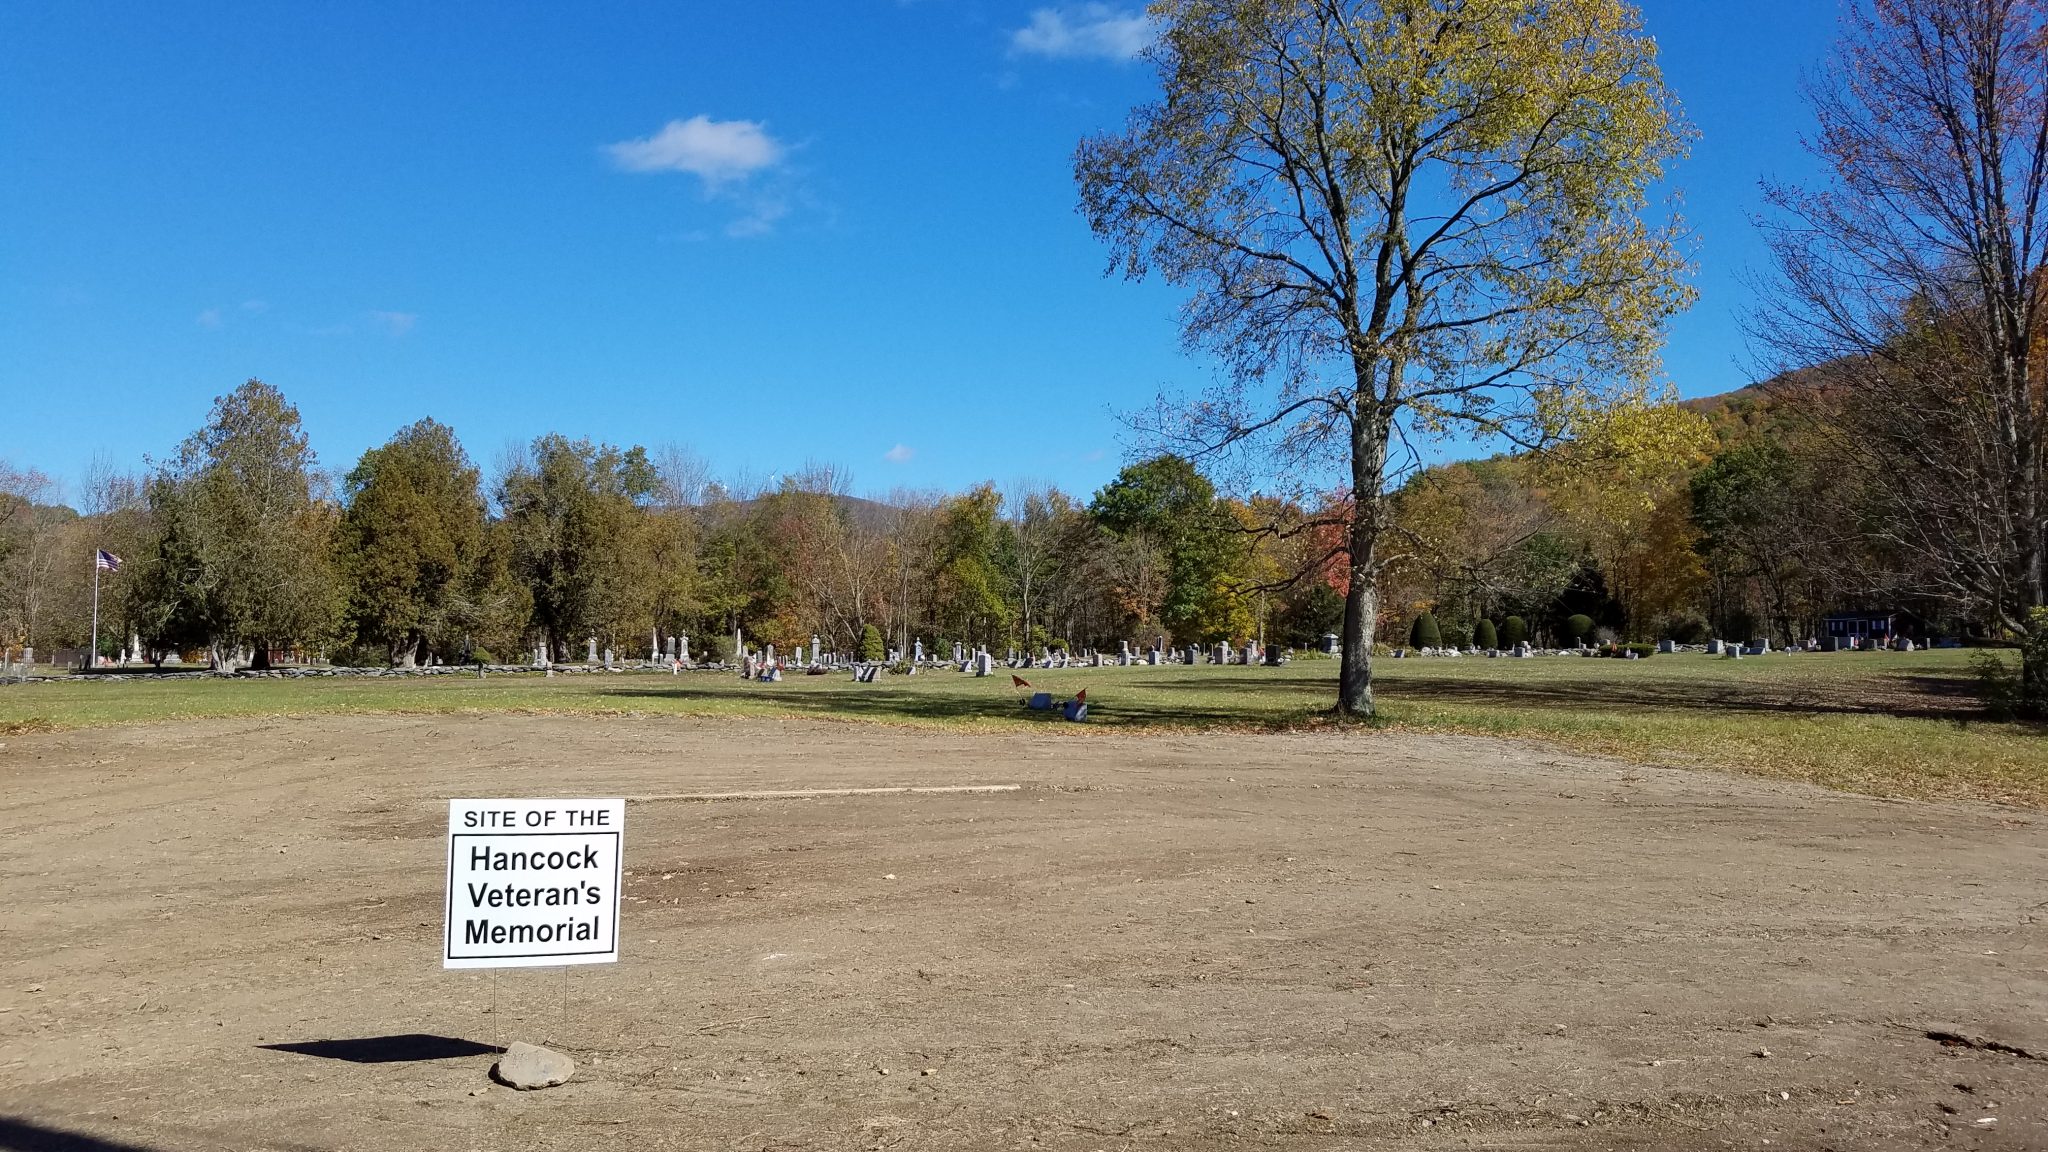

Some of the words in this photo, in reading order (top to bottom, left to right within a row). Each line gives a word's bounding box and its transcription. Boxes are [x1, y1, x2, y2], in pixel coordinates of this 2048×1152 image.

[464, 810, 517, 828] SITE
[525, 810, 557, 827] OF
[565, 809, 610, 826] THE
[470, 844, 599, 871] Hancock
[467, 880, 601, 908] Veteran's
[465, 915, 600, 945] Memorial
